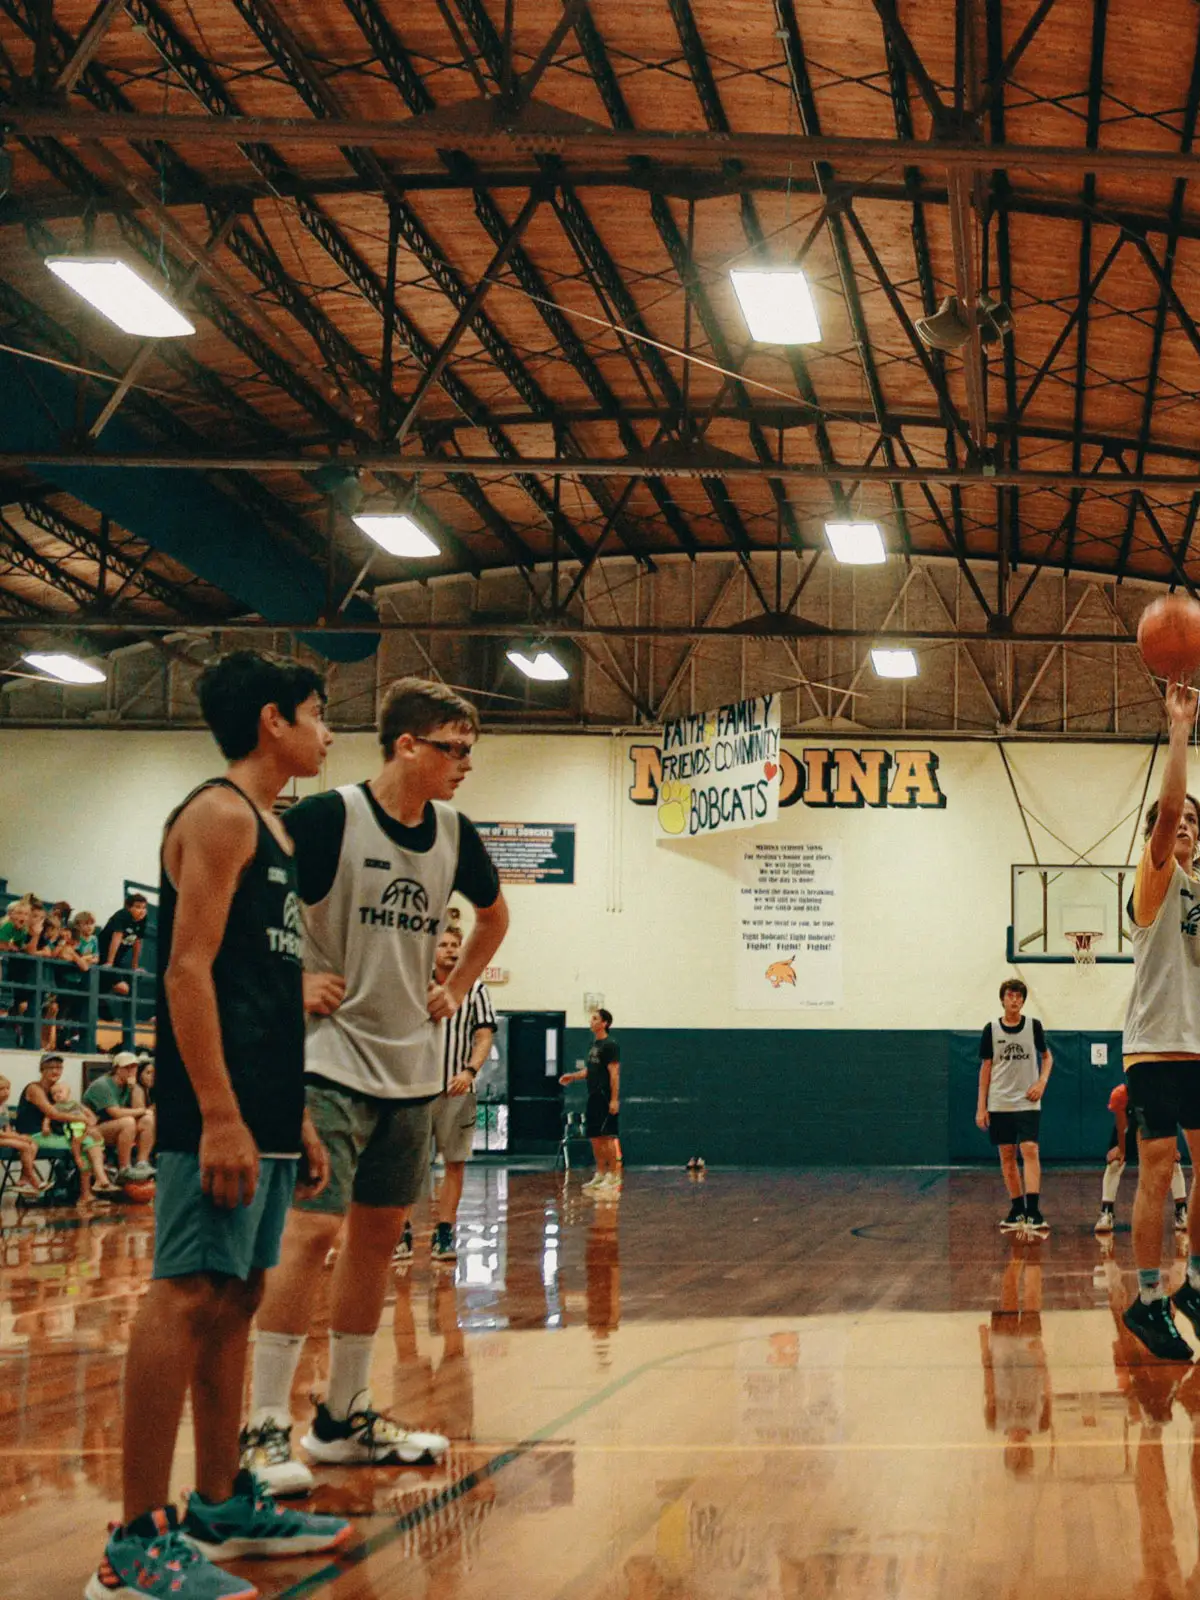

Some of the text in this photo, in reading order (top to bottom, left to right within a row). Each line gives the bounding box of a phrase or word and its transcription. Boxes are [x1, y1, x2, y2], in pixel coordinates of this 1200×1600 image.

[663, 694, 773, 751] FAITH FAMILY
[629, 744, 947, 809] MDINA
[660, 746, 711, 782] FRIENDS
[690, 779, 768, 835] BOBCATS
[359, 906, 394, 927] THE
[1180, 921, 1198, 936] HE
